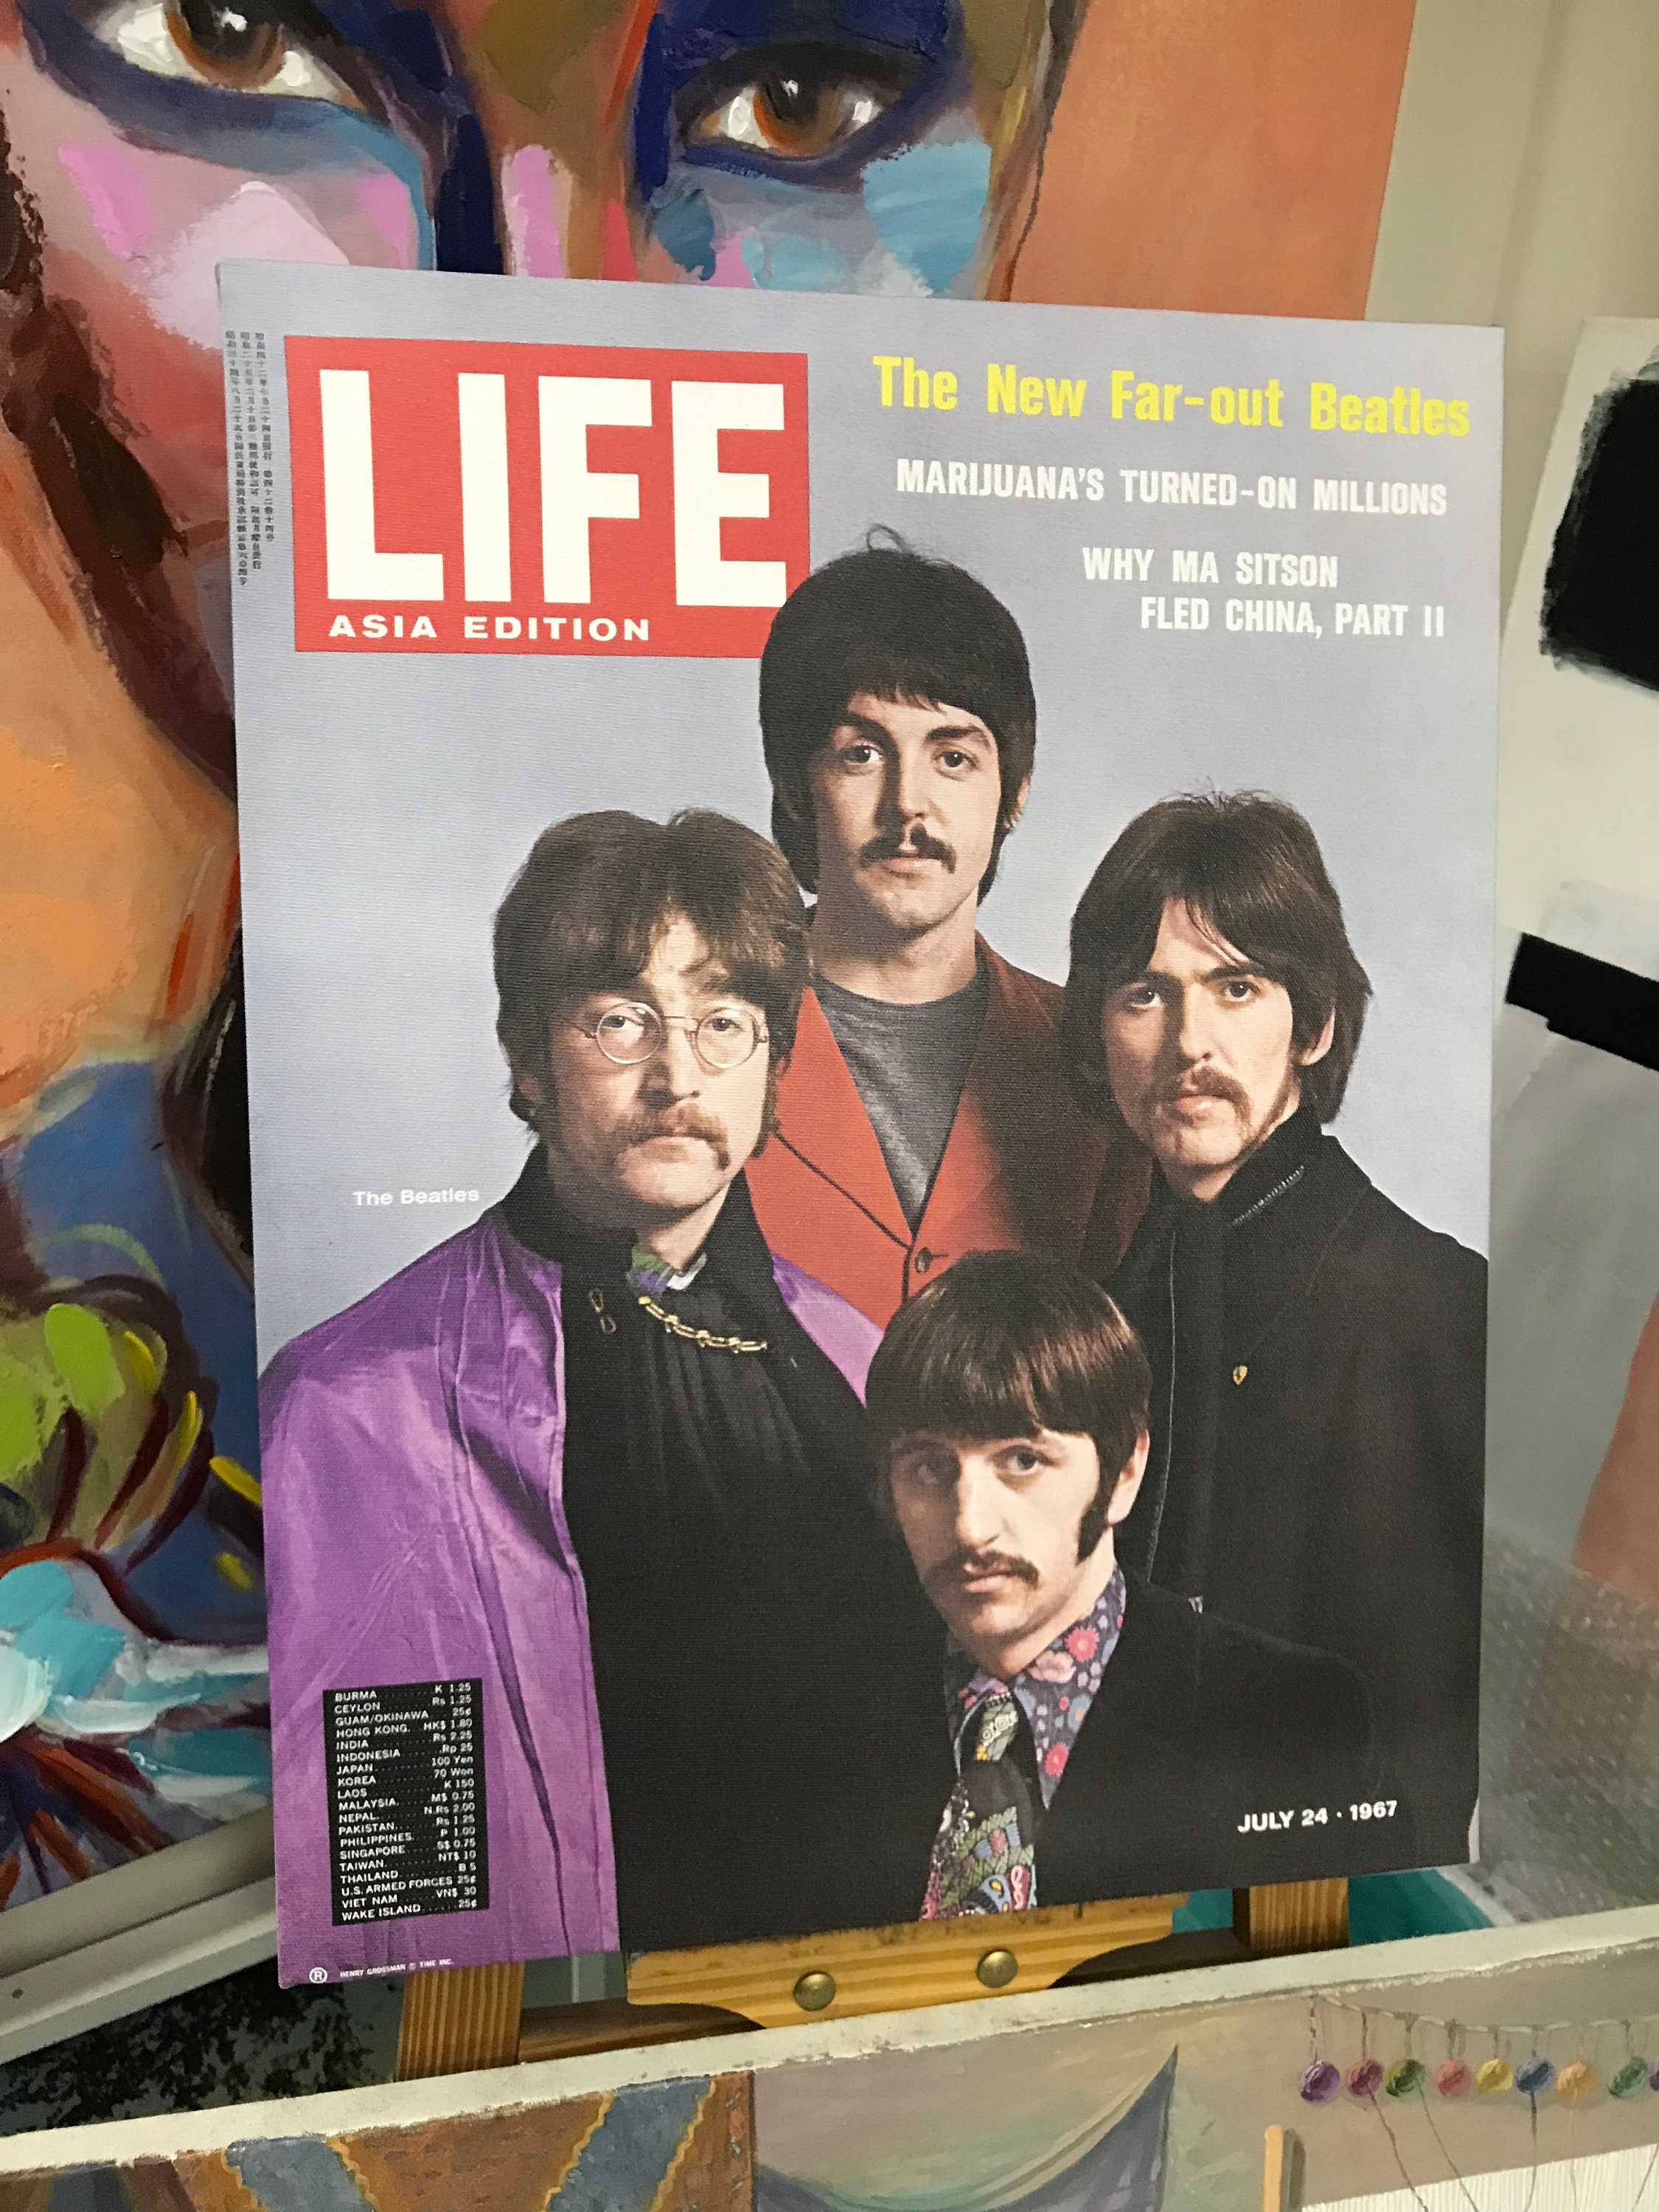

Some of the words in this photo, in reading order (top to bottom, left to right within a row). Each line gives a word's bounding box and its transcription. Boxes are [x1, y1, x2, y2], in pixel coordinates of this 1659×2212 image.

[873, 355, 959, 411] The
[986, 364, 1087, 417] New
[1110, 371, 1284, 428] Far-out
[1310, 382, 1470, 437] Beatles
[319, 369, 787, 608] LIFE
[897, 458, 1104, 501] MARIJUANA'S
[1120, 469, 1296, 510] TURNED-ON
[1313, 478, 1447, 515] MILLIONS
[1082, 546, 1154, 582] WHY
[1172, 550, 1219, 583] MA
[1235, 552, 1338, 588] SITSON
[1141, 597, 1209, 630] FLED
[1225, 599, 1323, 639] CHINA,
[1335, 604, 1409, 636] PART
[1423, 606, 1444, 637] II
[329, 615, 437, 639] ASIA
[464, 617, 649, 641] EDITION
[352, 1191, 393, 1206] The
[400, 1188, 479, 1204] Beatles
[335, 1690, 378, 1702] BURMA
[434, 1685, 442, 1694] K
[334, 1702, 380, 1714] CEYLON
[335, 1711, 429, 1725] GUAM/OKINAWA
[336, 1727, 370, 1738] HONG
[375, 1724, 408, 1735] KONG
[423, 1720, 445, 1731] HK$
[335, 1739, 369, 1750] INDIA
[336, 1749, 400, 1762] INDONESIA
[460, 1742, 473, 1751] 25
[336, 1764, 373, 1775] JAPAN
[432, 1756, 450, 1766] 100
[454, 1755, 473, 1764] Yen
[337, 1775, 376, 1787] KOREA
[434, 1768, 447, 1778] 70
[451, 1767, 473, 1776] Won
[337, 1788, 367, 1798] LAOS
[444, 1780, 451, 1788] K
[338, 1798, 397, 1811] MALAYSIA
[338, 1812, 376, 1823] NEPAL
[1237, 1810, 1294, 1833] JULY
[1301, 1807, 1328, 1826] 24
[1349, 1801, 1397, 1820] 1967
[338, 1823, 394, 1835] PAKISTAN
[340, 1832, 411, 1847] PHILIPPINES
[339, 1845, 406, 1860] SINGAPORE
[339, 1859, 384, 1871] TAIWAN
[438, 1852, 459, 1862] NT$
[464, 1850, 476, 1860] 10
[341, 1870, 398, 1884] THAILAND
[470, 1862, 476, 1871] 5
[366, 1880, 406, 1893] ARMED
[409, 1876, 452, 1889] FORCES
[341, 1898, 366, 1908] VIET
[372, 1894, 397, 1905] NAM
[436, 1888, 458, 1898] VN$
[464, 1886, 476, 1896] 30
[341, 1909, 375, 1921] WAKE
[378, 1904, 420, 1917] ISLAND
[341, 1969, 364, 1978] HENRY
[367, 1964, 406, 1975] GROSSMAN
